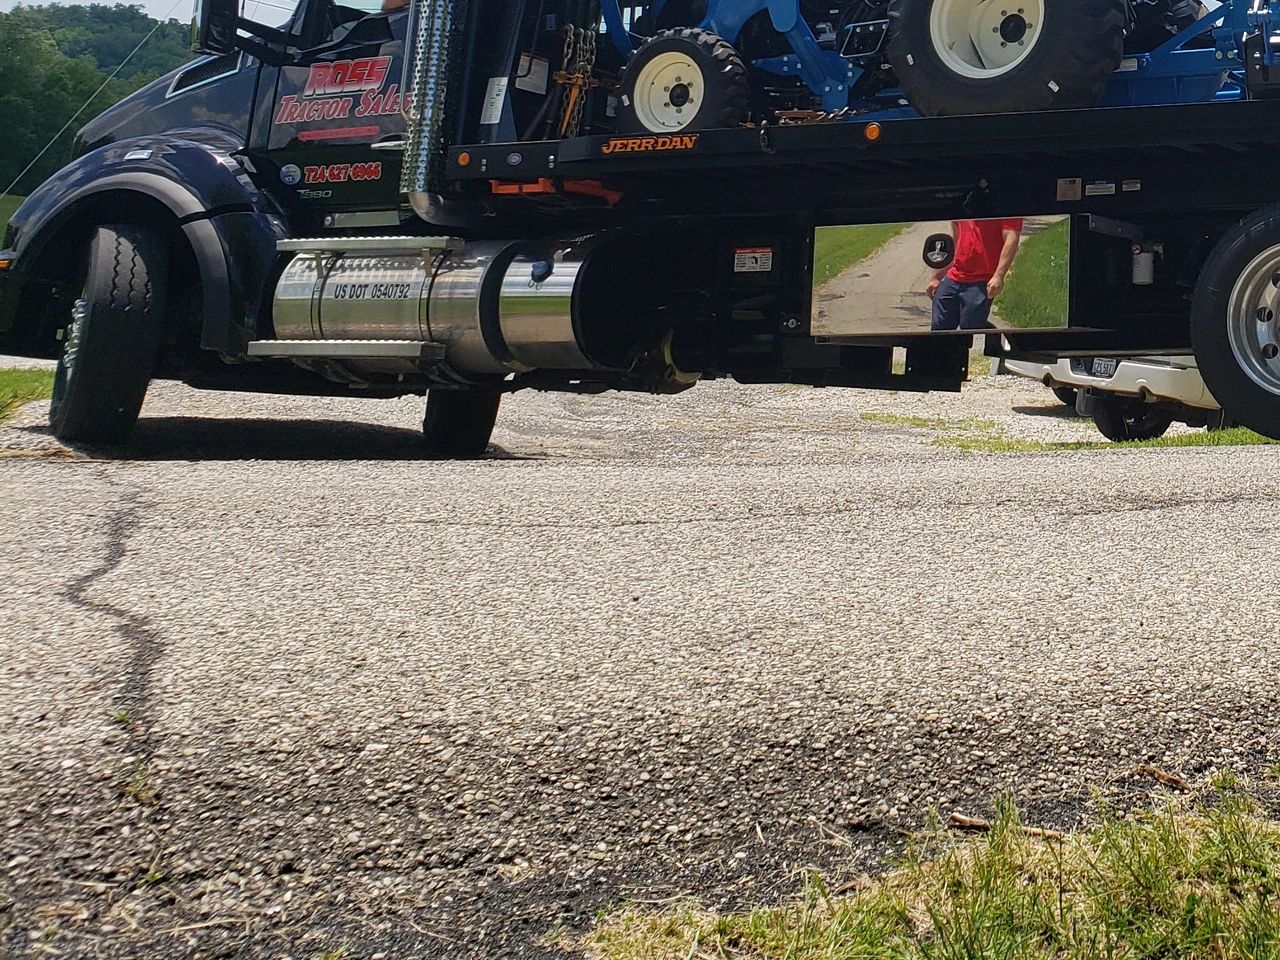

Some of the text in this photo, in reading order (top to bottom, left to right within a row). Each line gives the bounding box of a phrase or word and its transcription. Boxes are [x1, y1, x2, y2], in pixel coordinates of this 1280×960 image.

[303, 57, 392, 98] ROSS
[601, 135, 698, 154] JERR-DAN
[334, 283, 411, 299] US DOT 0540792
